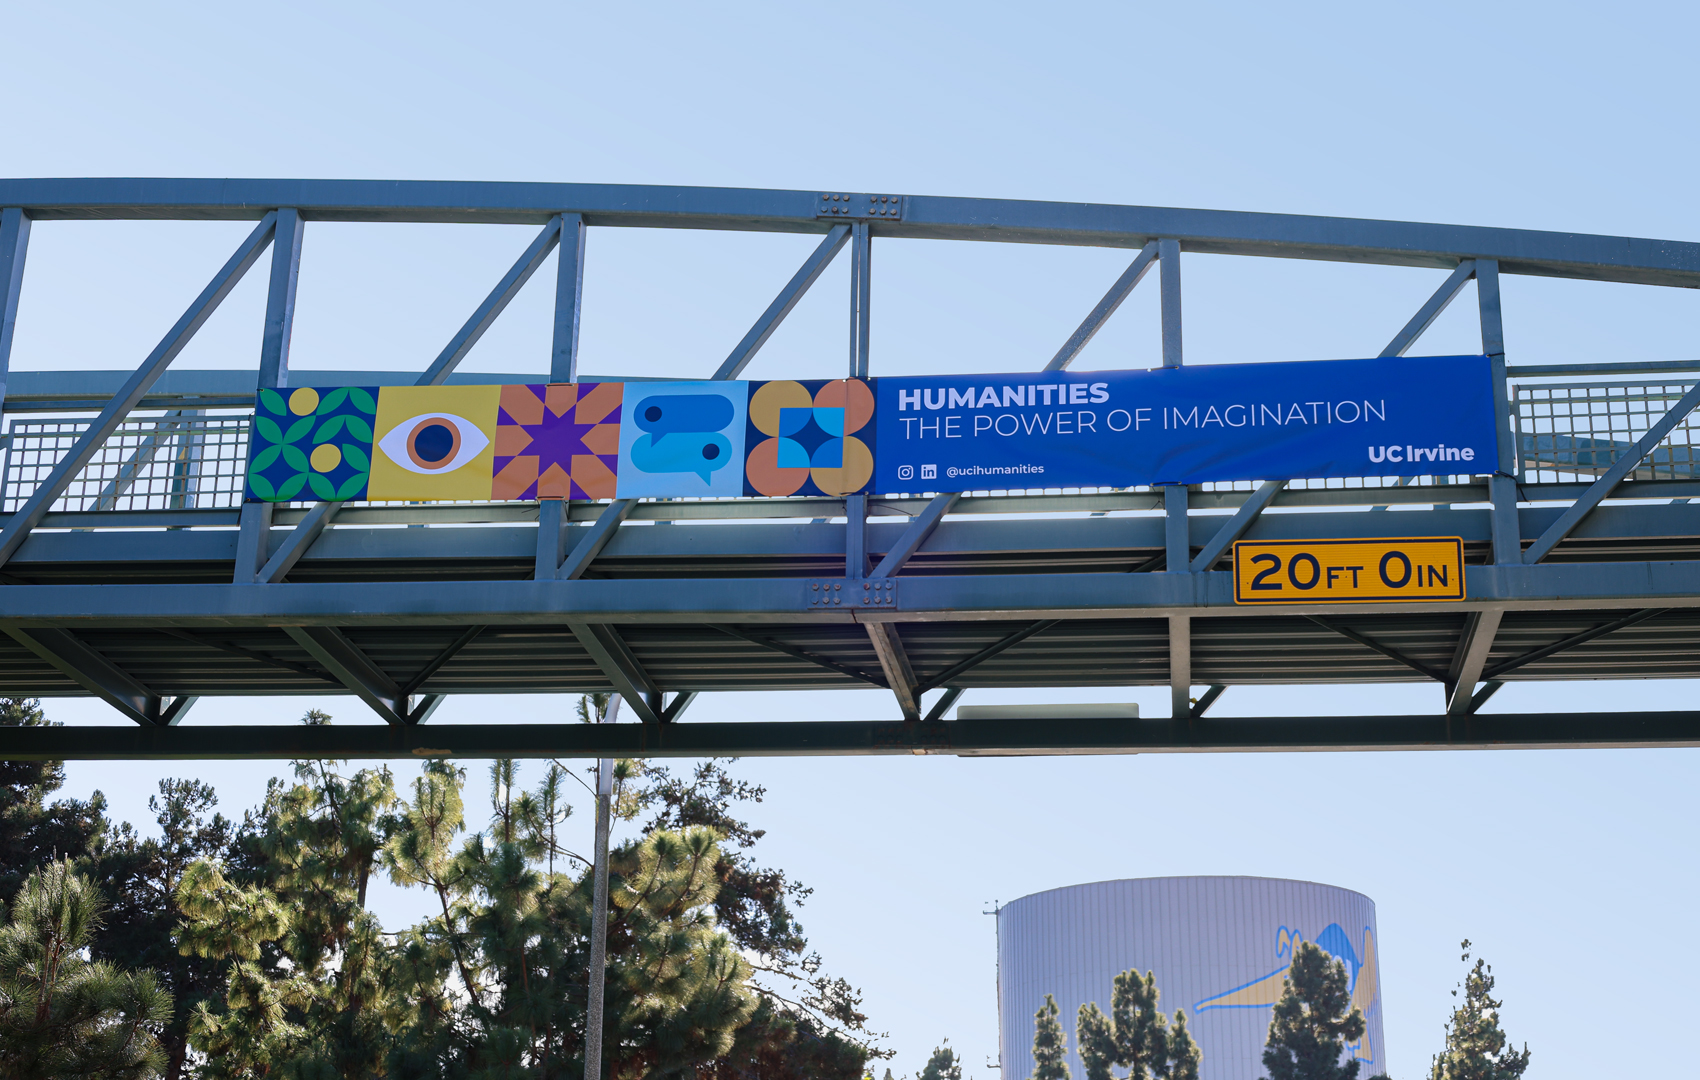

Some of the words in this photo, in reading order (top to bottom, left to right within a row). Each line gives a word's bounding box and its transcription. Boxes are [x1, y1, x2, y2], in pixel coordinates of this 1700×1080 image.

[898, 382, 1110, 411] HUMANITIES
[899, 416, 962, 440] THE
[973, 411, 1097, 437] POWER
[1107, 408, 1152, 432] OF
[1163, 399, 1386, 430] IMAGINATION
[946, 463, 1045, 478] @ucihumanities
